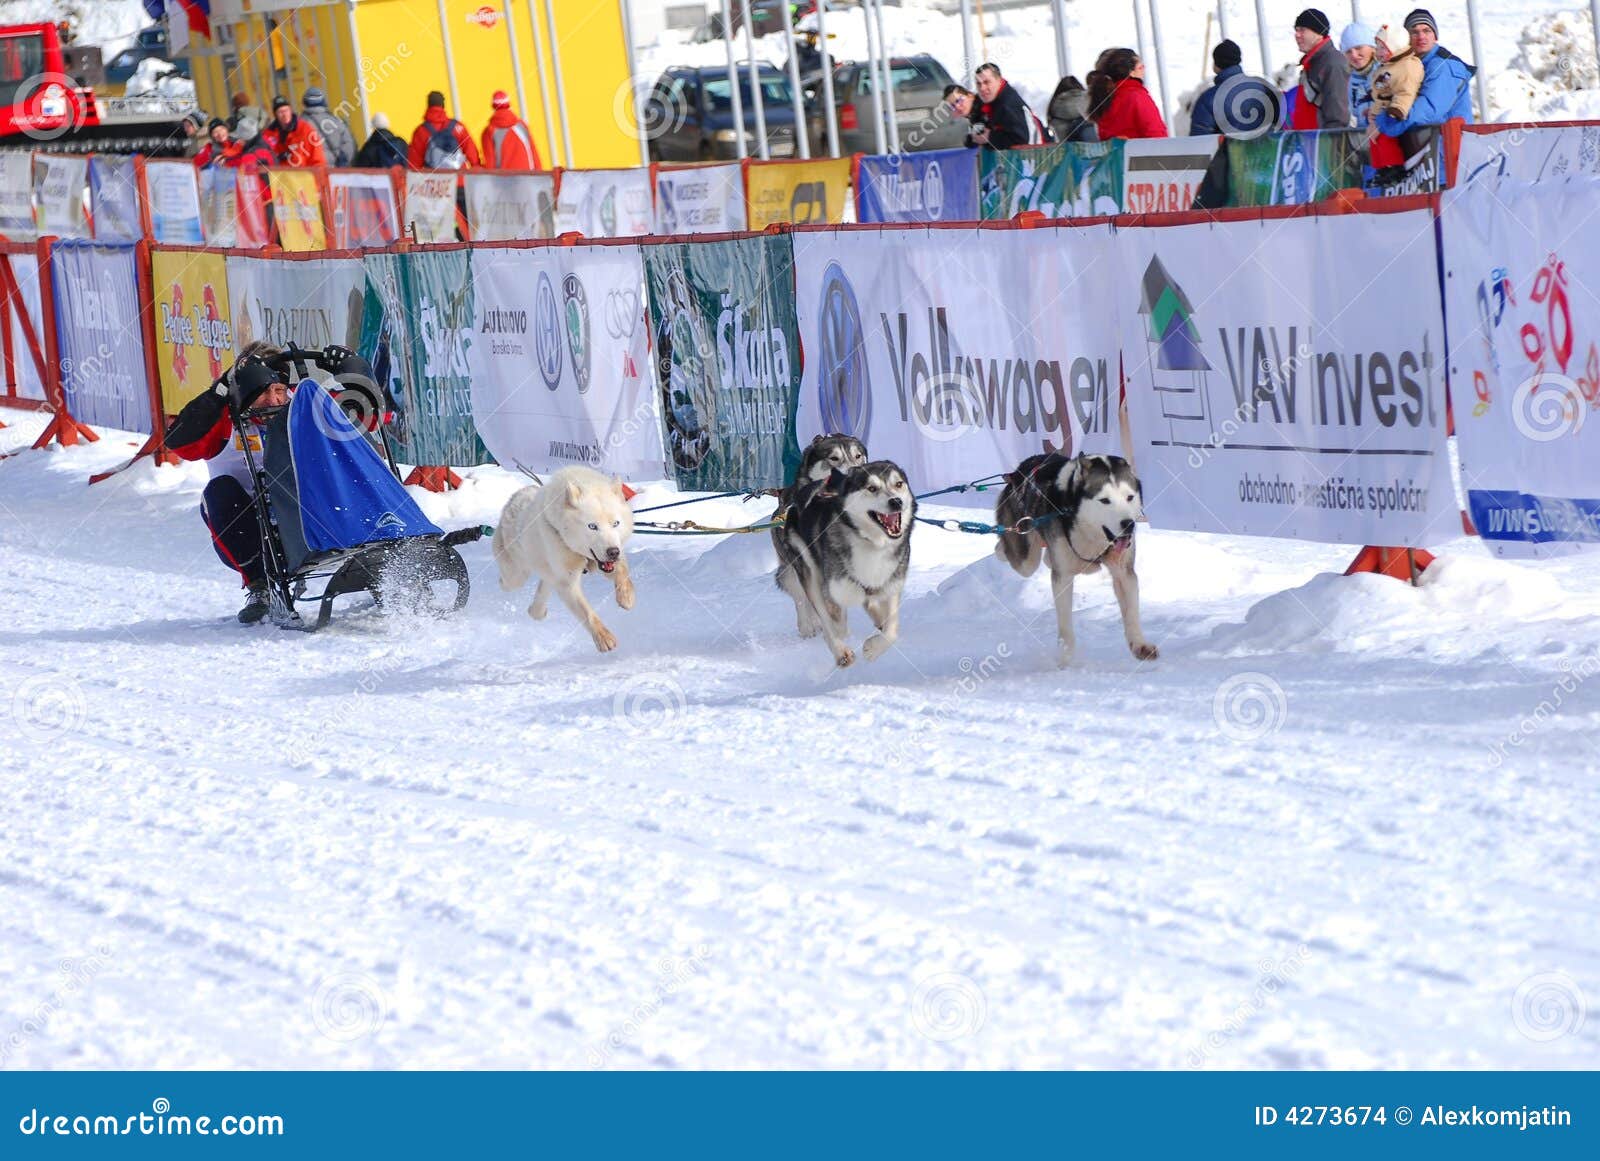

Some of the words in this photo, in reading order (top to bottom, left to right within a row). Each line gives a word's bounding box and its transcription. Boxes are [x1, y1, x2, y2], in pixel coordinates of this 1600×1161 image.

[880, 307, 1108, 456] Volkswagen
[1218, 326, 1297, 424] VAV
[1308, 326, 1437, 428] Invest
[1239, 472, 1296, 506] obchodno
